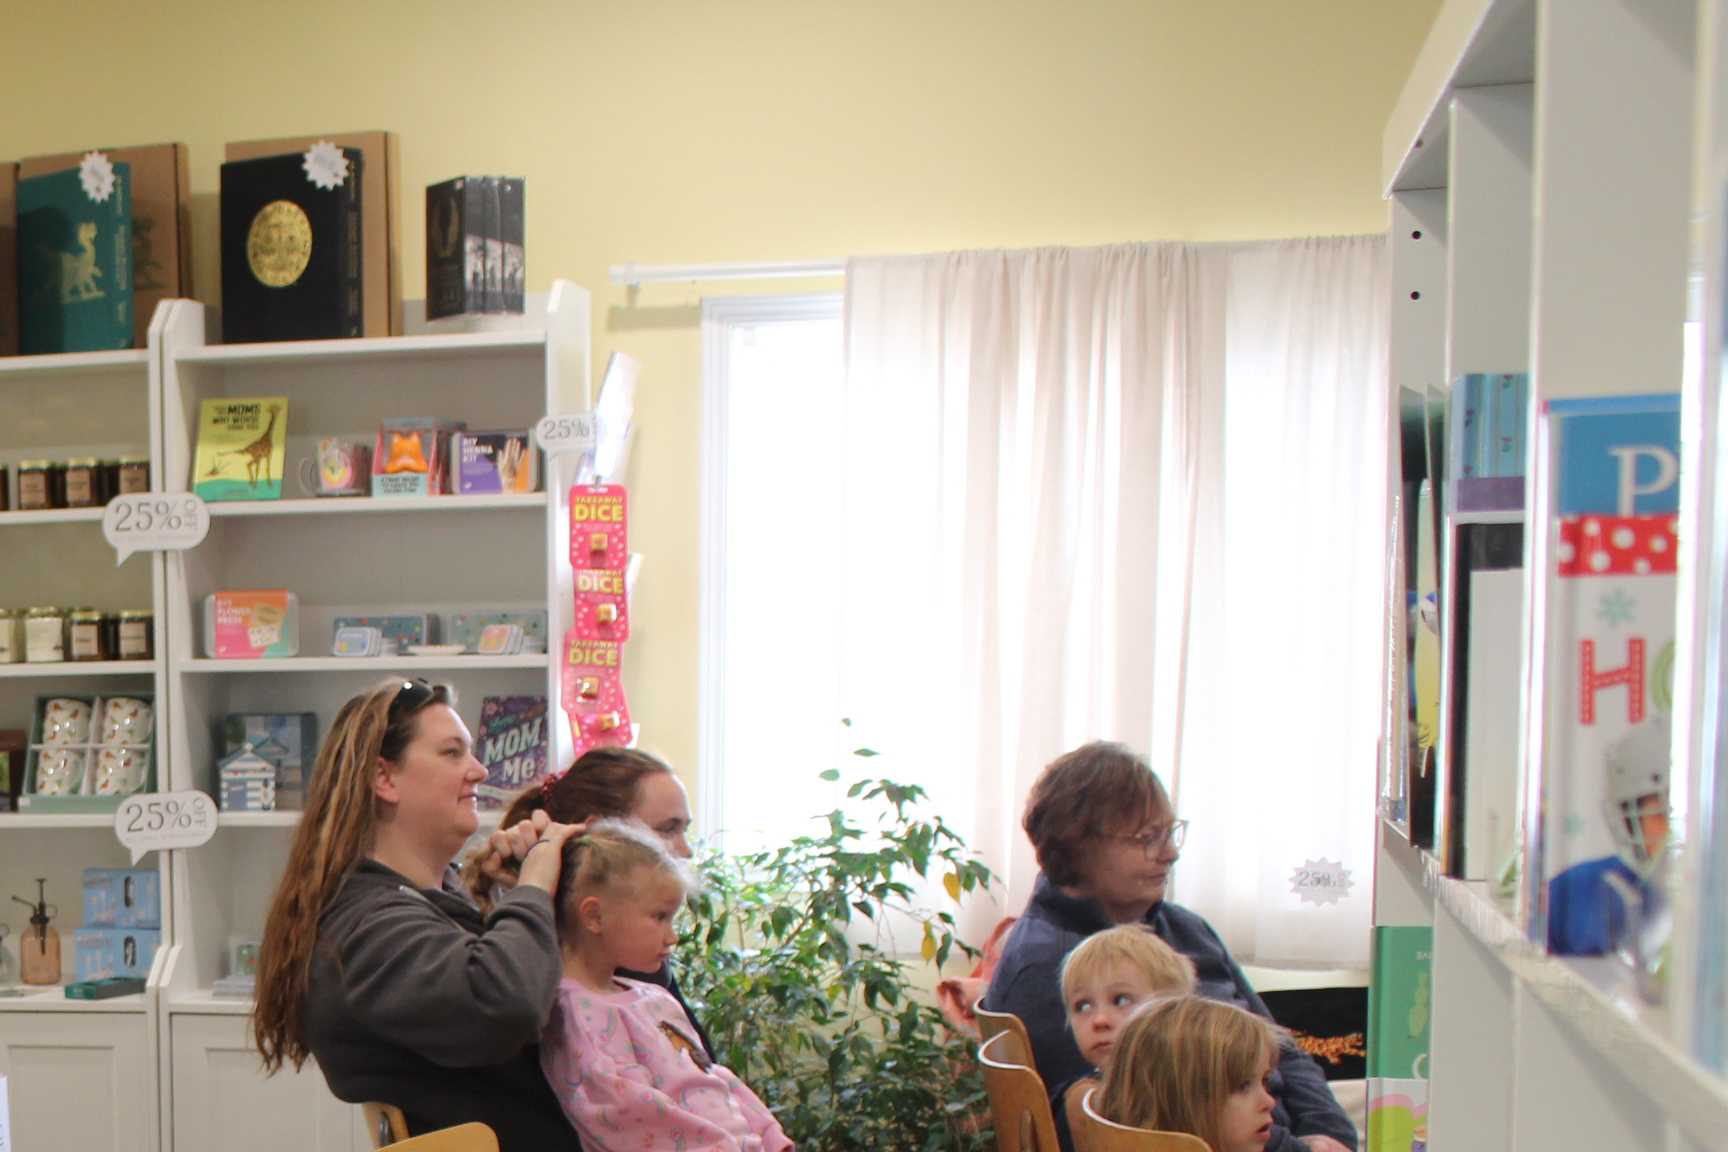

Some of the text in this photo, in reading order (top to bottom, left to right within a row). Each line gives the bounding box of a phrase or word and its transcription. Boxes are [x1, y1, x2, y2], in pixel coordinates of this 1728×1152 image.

[543, 418, 593, 441] 25%
[463, 436, 478, 447] DIY
[463, 455, 477, 465] KIT
[575, 495, 624, 506] TAKEAWAY
[115, 498, 199, 534] 25% OFF
[574, 504, 625, 522] DICE
[578, 575, 625, 595] DICE
[569, 648, 619, 667] DICE
[483, 716, 543, 768] MOM
[502, 756, 537, 784] Me
[125, 796, 208, 834] 25% OFF
[1297, 871, 1337, 889] 25%
